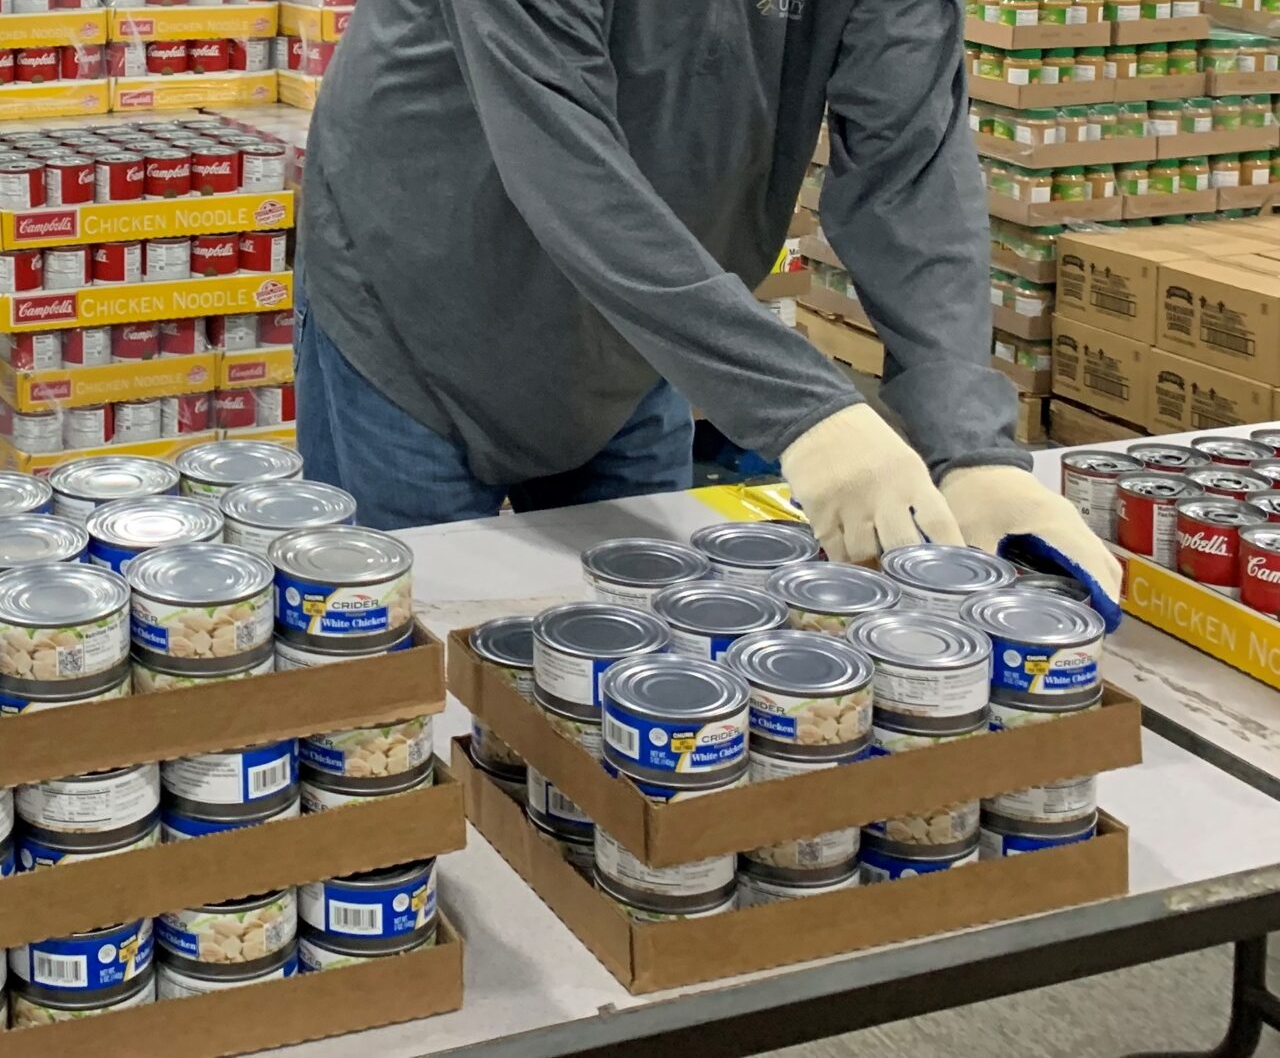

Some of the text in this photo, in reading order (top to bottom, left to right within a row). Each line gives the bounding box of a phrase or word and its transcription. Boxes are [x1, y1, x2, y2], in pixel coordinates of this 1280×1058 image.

[147, 163, 190, 181] Campbell
[192, 161, 232, 176] ampbell's
[19, 217, 73, 235] Campbell's
[84, 214, 167, 235] CHICKEN
[175, 208, 249, 230] NOODLE
[18, 298, 73, 318] Campbell's
[81, 296, 164, 318] CHICKEN
[173, 289, 248, 310] NOODLE
[76, 380, 128, 394] CHICKEN
[134, 374, 183, 388] NOODLE
[1177, 530, 1229, 556] mpbell's
[331, 599, 379, 610] CRIDER
[322, 617, 350, 629] White
[352, 615, 387, 629] Chicken
[1132, 577, 1237, 652] CHICKEN
[137, 626, 166, 644] Chicken
[1045, 675, 1071, 685] White
[750, 698, 786, 715] RIDER
[758, 717, 794, 734] Chicken
[701, 729, 740, 743] CRIDER
[310, 752, 343, 767] Chicken
[691, 750, 718, 762] White
